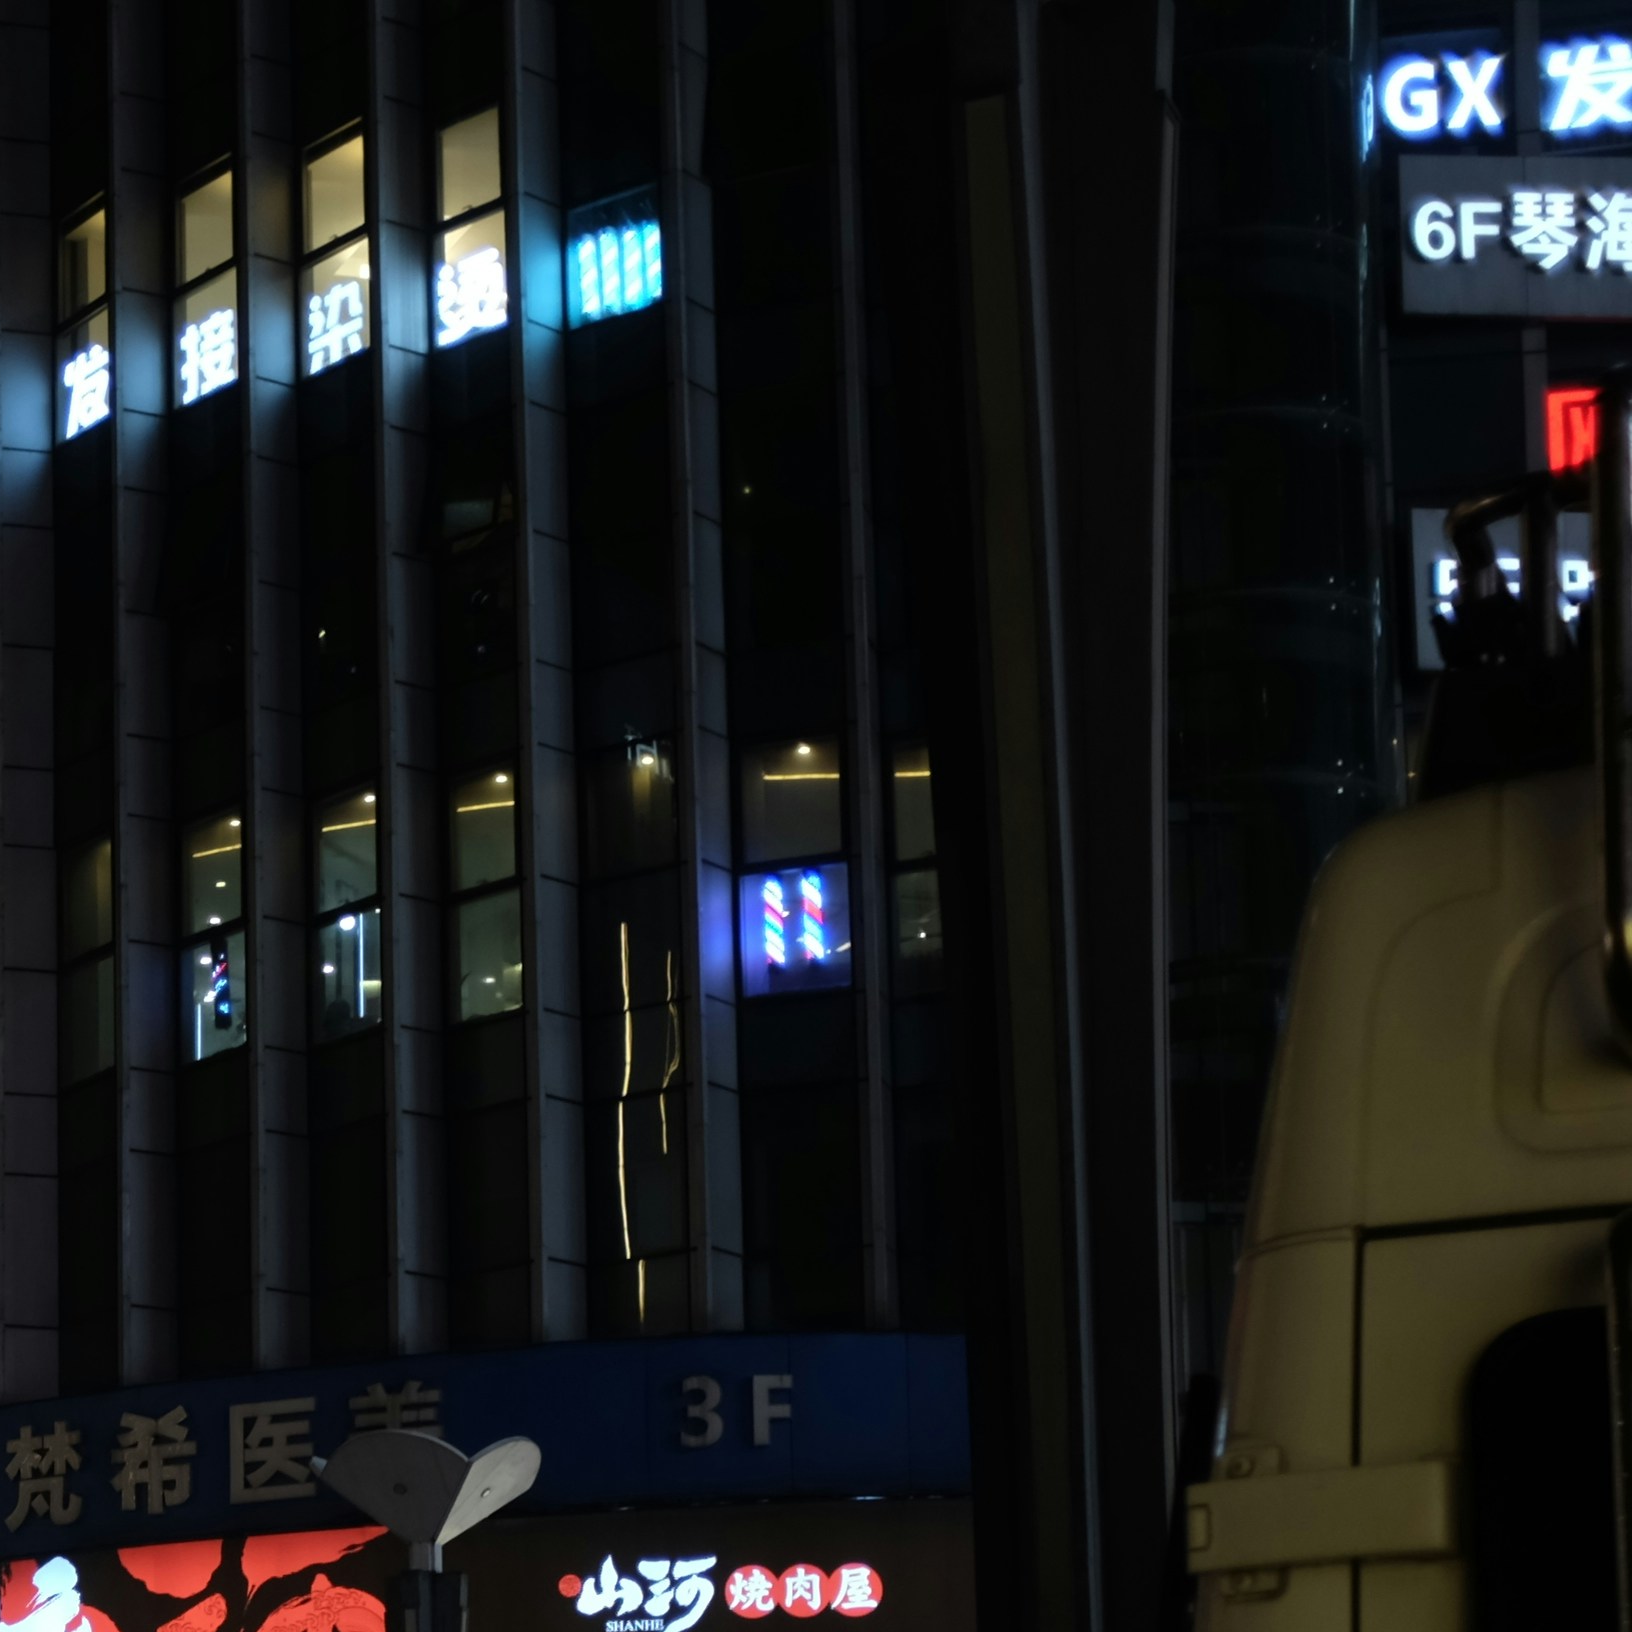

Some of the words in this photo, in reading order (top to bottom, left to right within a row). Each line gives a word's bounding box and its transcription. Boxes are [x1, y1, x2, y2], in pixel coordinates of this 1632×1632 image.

[1384, 55, 1504, 131] GX
[1414, 200, 1502, 260] 6F
[1511, 191, 1632, 271] 琴海
[678, 1374, 794, 1447] 3F
[606, 1618, 664, 1632] SHANHE
